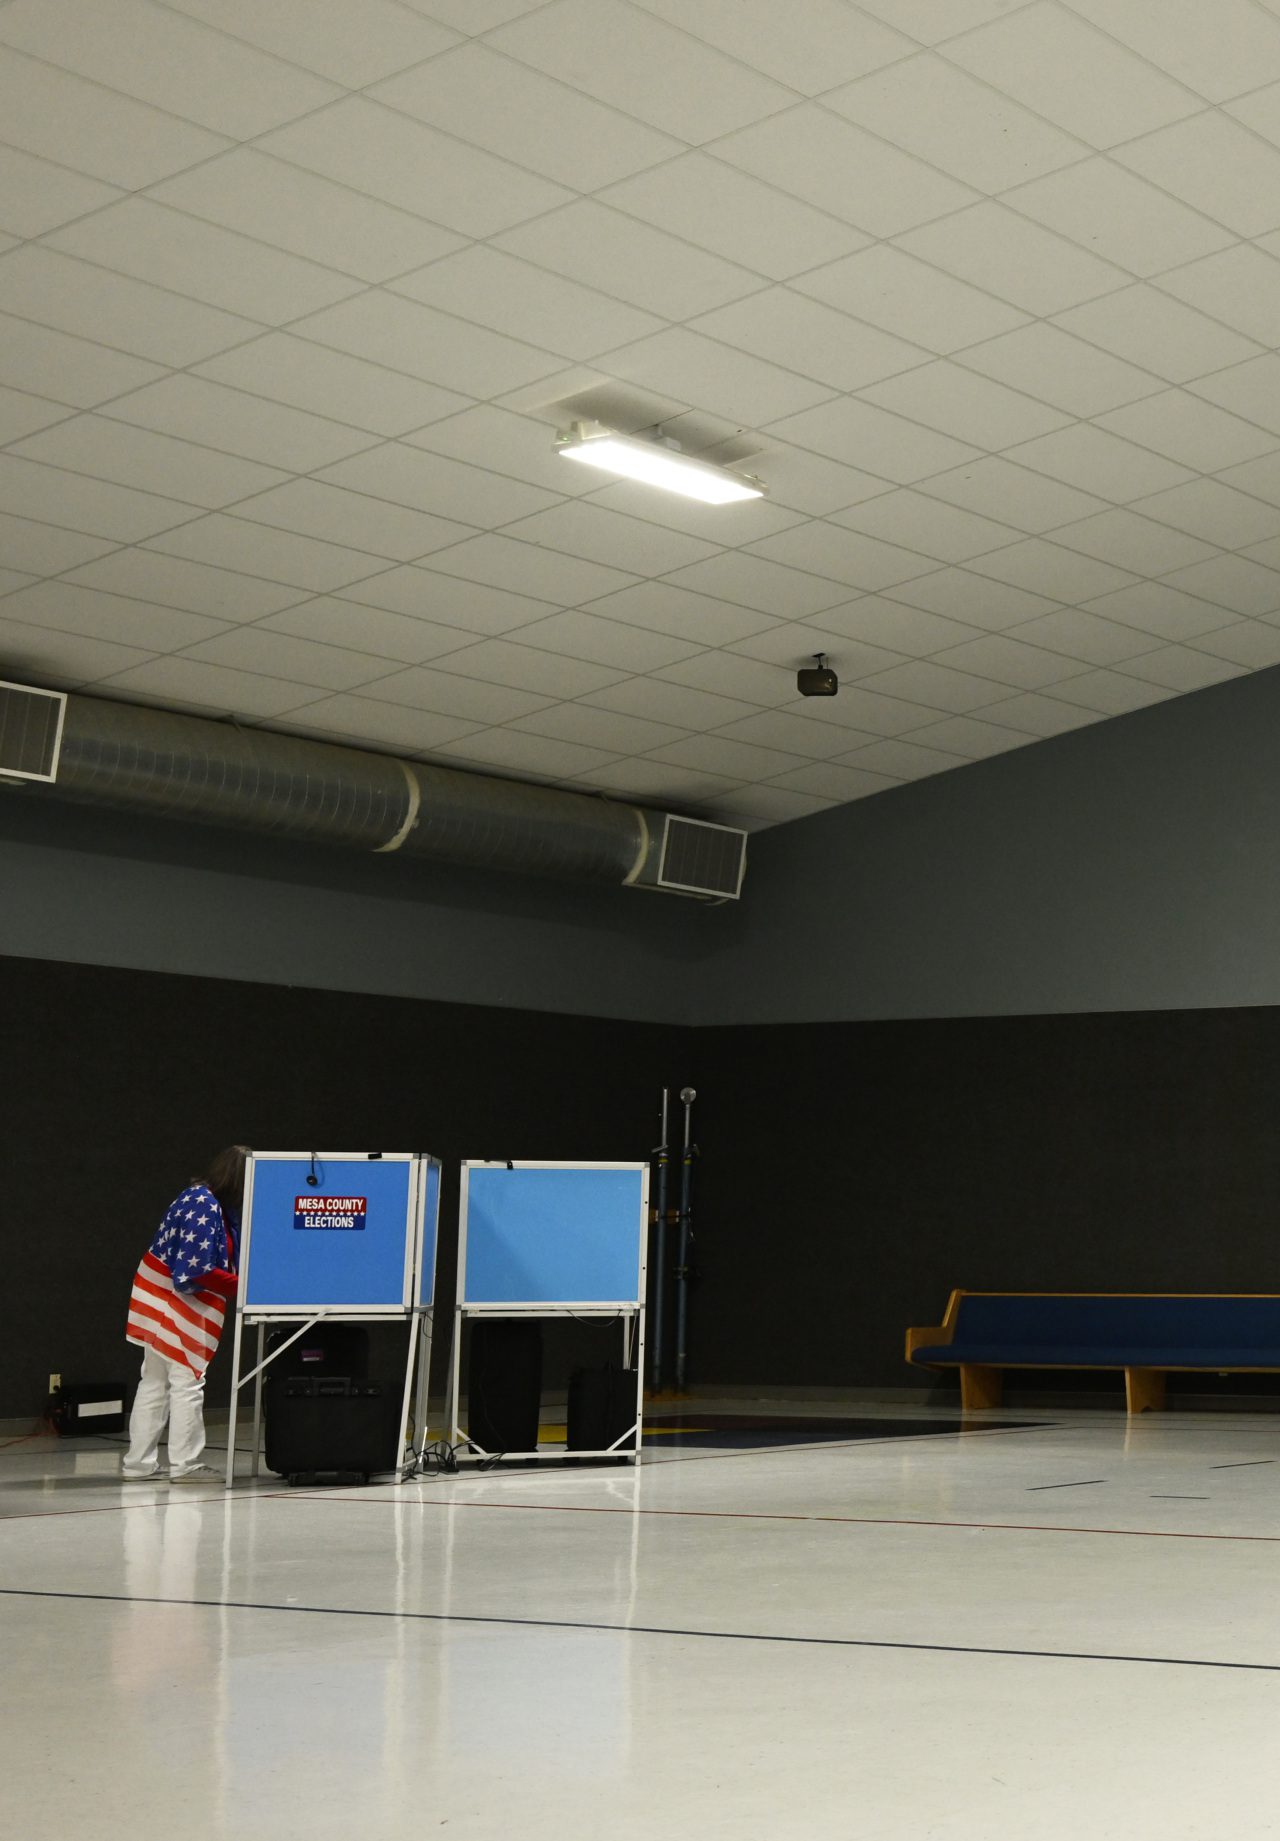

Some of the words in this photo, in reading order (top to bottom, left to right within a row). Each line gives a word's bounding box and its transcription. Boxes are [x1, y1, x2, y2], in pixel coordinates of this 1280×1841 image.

[298, 1198, 325, 1209] MESA
[326, 1199, 363, 1210] COUNTY
[304, 1216, 354, 1228] ELECTIONS
